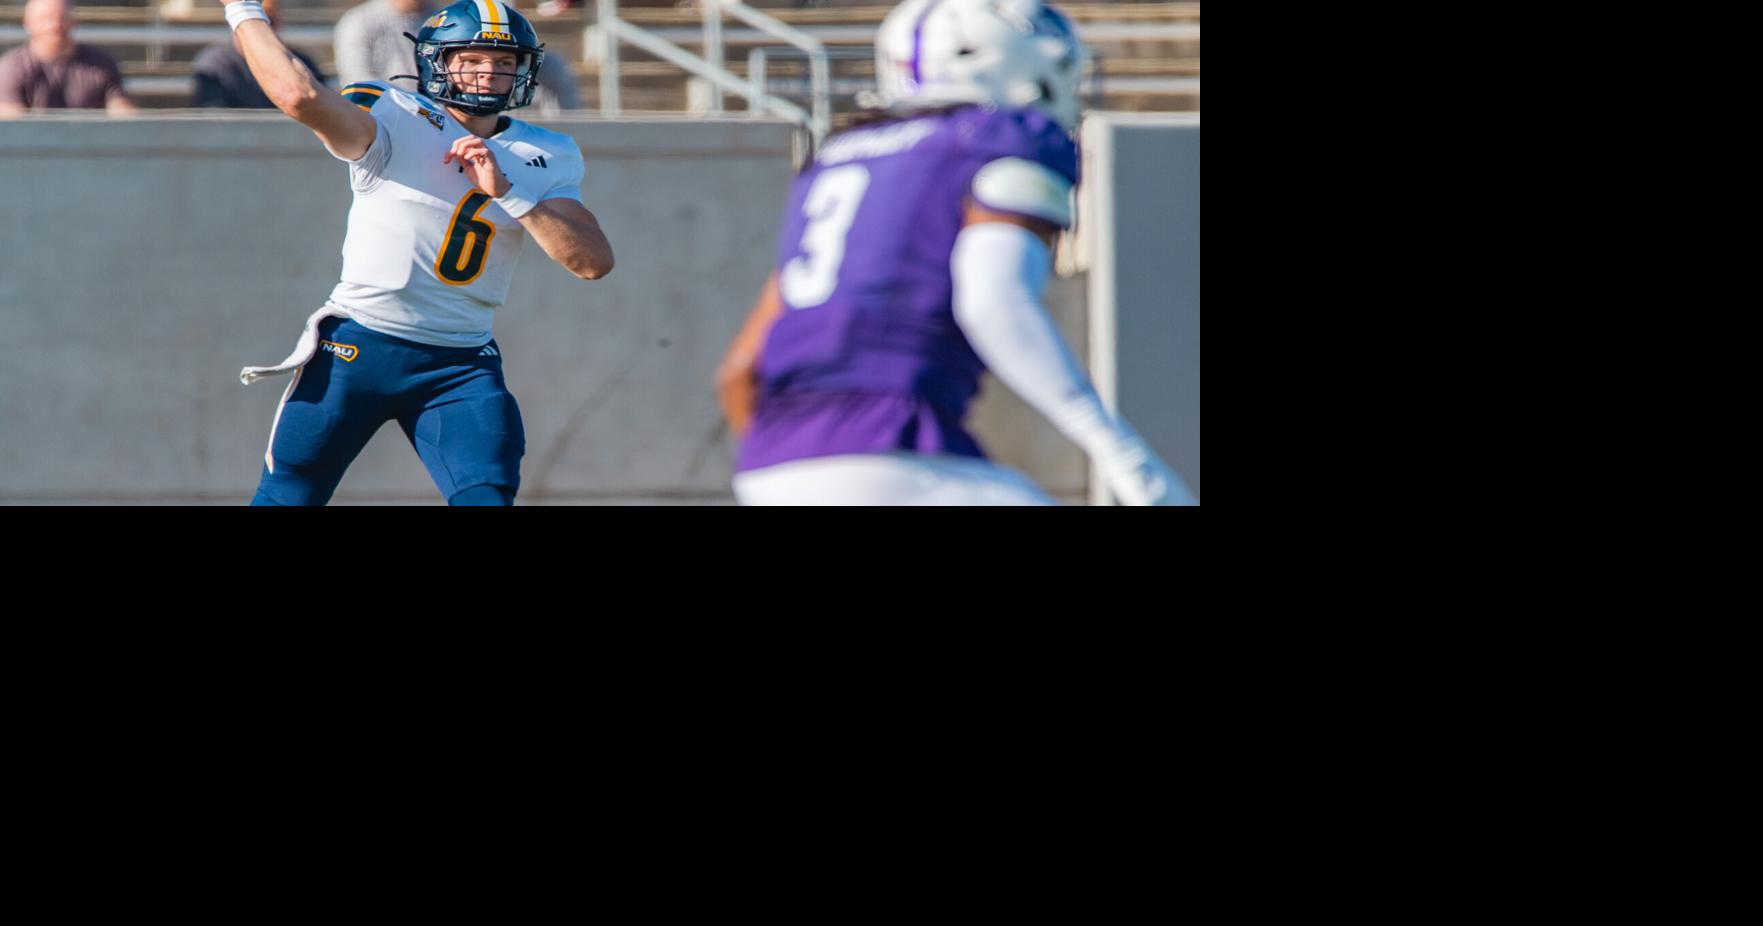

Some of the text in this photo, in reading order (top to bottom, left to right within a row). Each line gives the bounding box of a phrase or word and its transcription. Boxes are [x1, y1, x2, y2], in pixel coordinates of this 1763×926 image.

[481, 31, 511, 41] NAU
[434, 188, 496, 286] 6
[780, 163, 871, 310] 3
[322, 343, 354, 357] NAU
